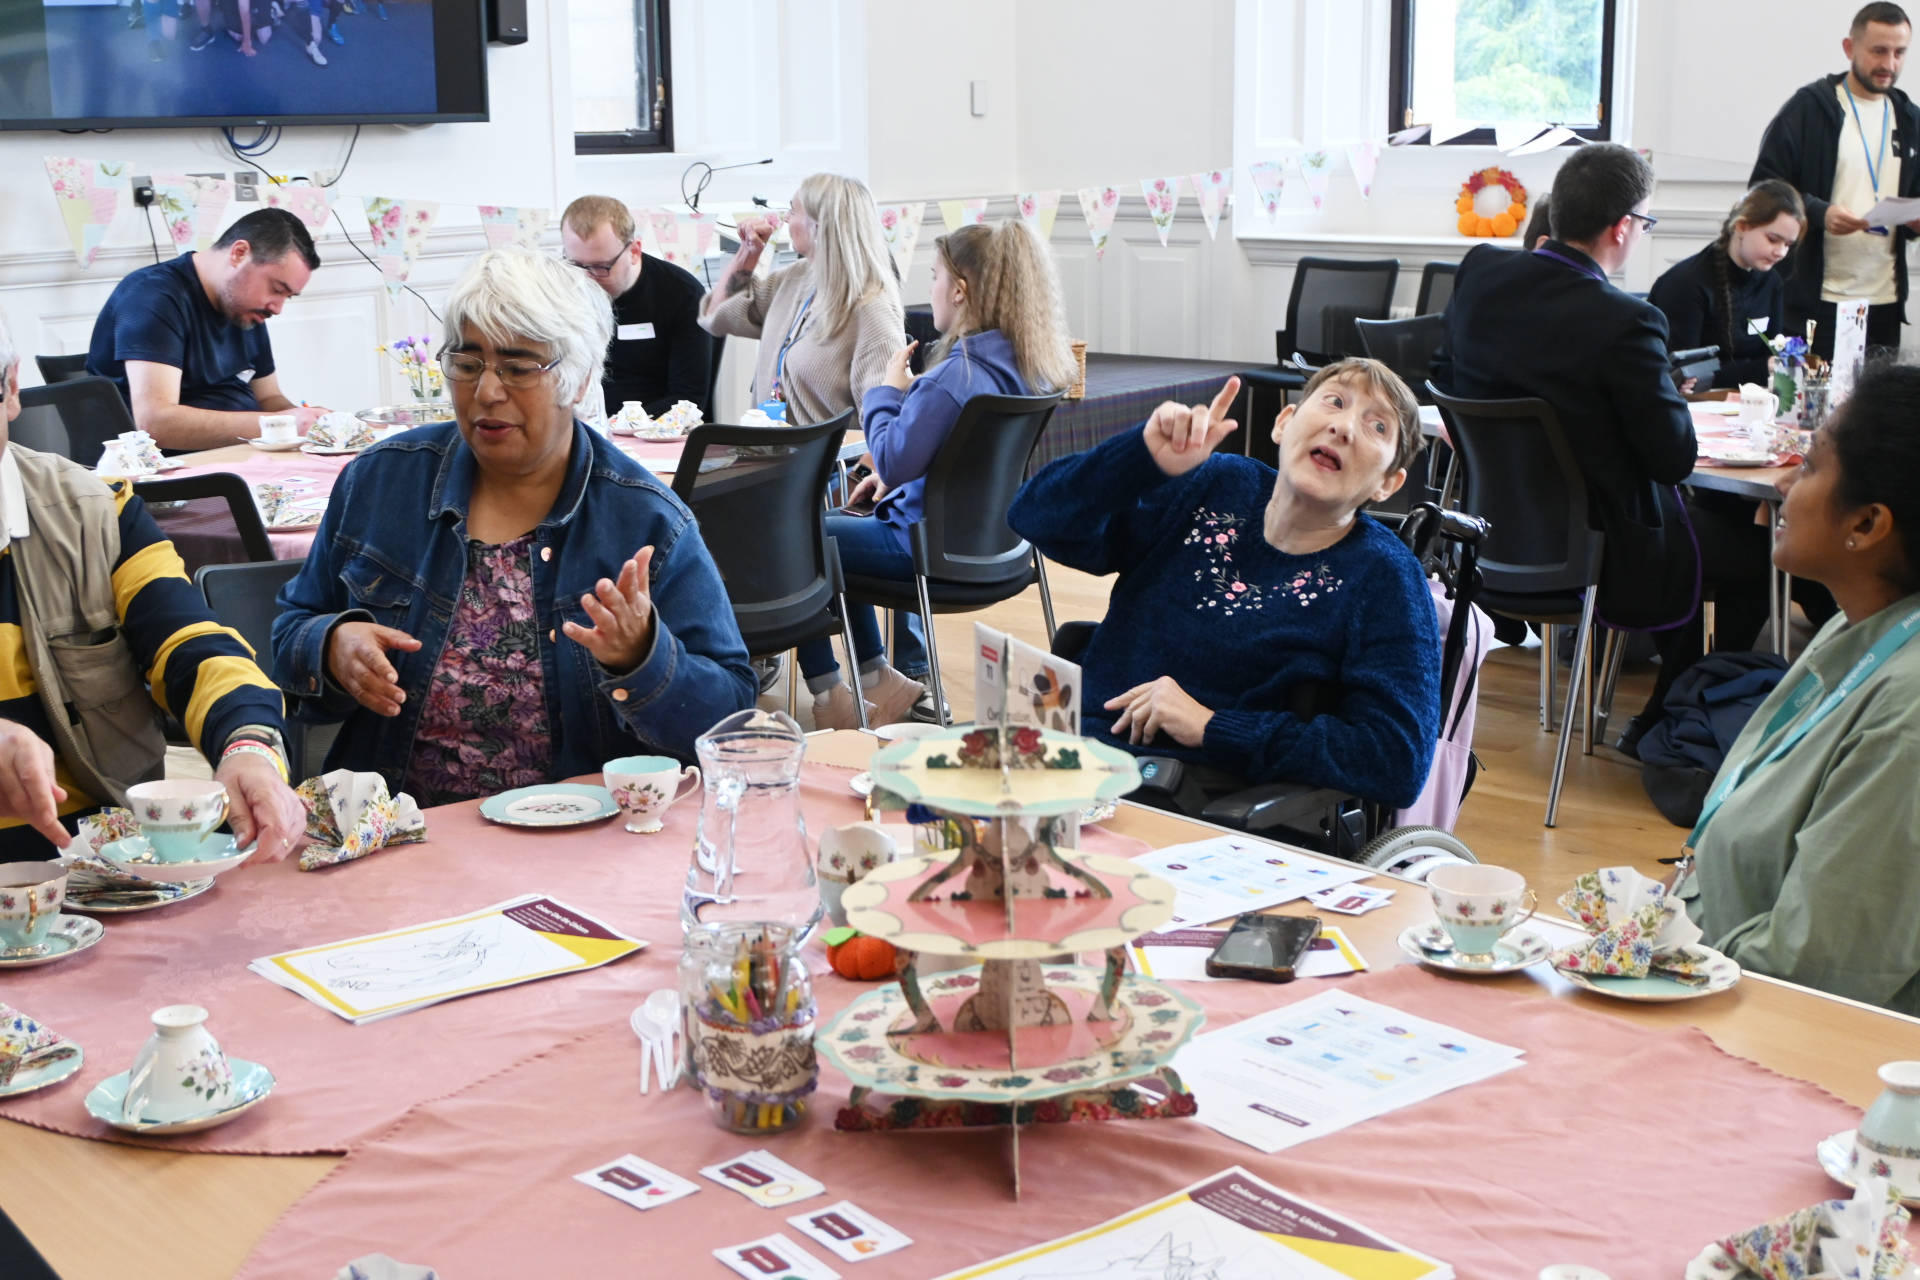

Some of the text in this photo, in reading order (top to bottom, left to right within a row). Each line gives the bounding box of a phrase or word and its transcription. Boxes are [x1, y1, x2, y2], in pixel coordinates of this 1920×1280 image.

[1229, 1183, 1261, 1202] Colour
[1281, 1208, 1299, 1219] the
[1298, 1215, 1338, 1237] Unicorn
